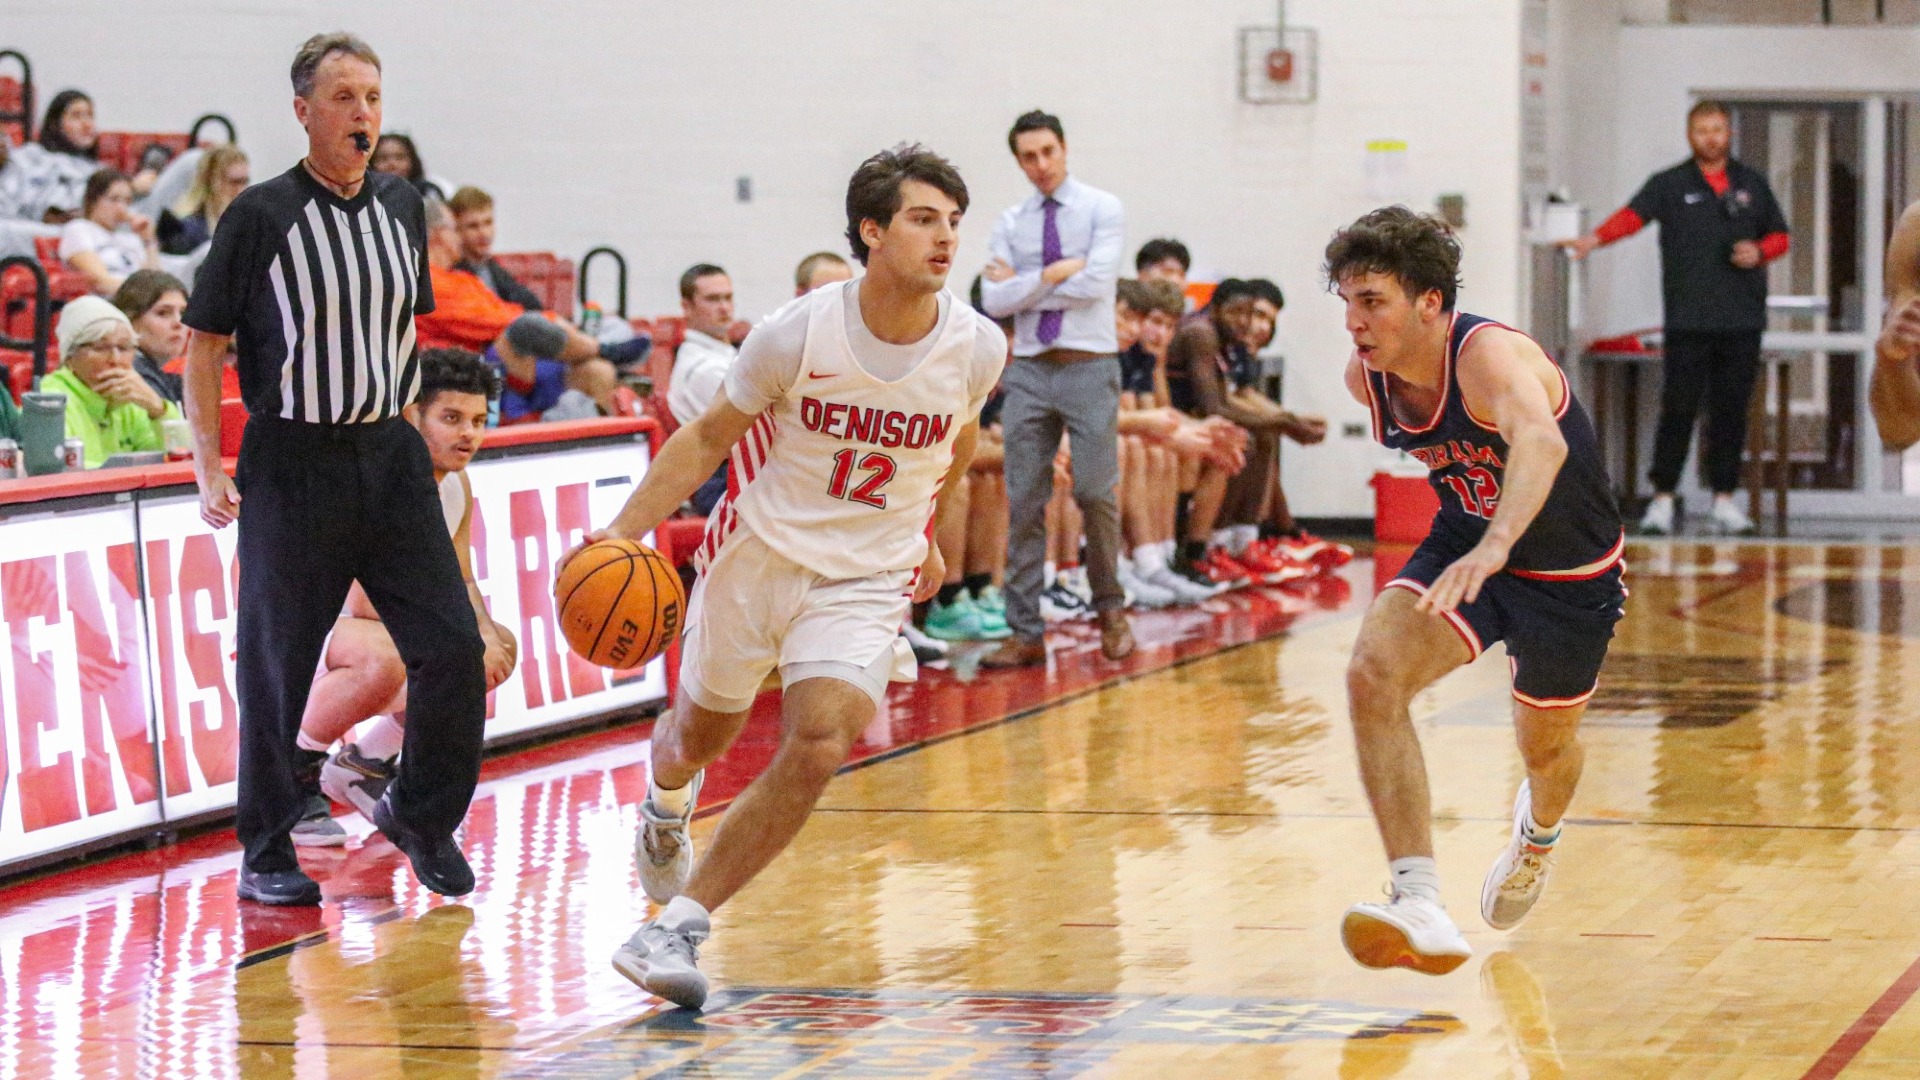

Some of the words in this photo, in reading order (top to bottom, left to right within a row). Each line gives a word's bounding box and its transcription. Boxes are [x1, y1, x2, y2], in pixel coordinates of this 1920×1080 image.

[800, 396, 953, 450] DENISON
[827, 448, 898, 510] 12
[1441, 467, 1500, 520] 12
[0, 533, 240, 833] ENIS
